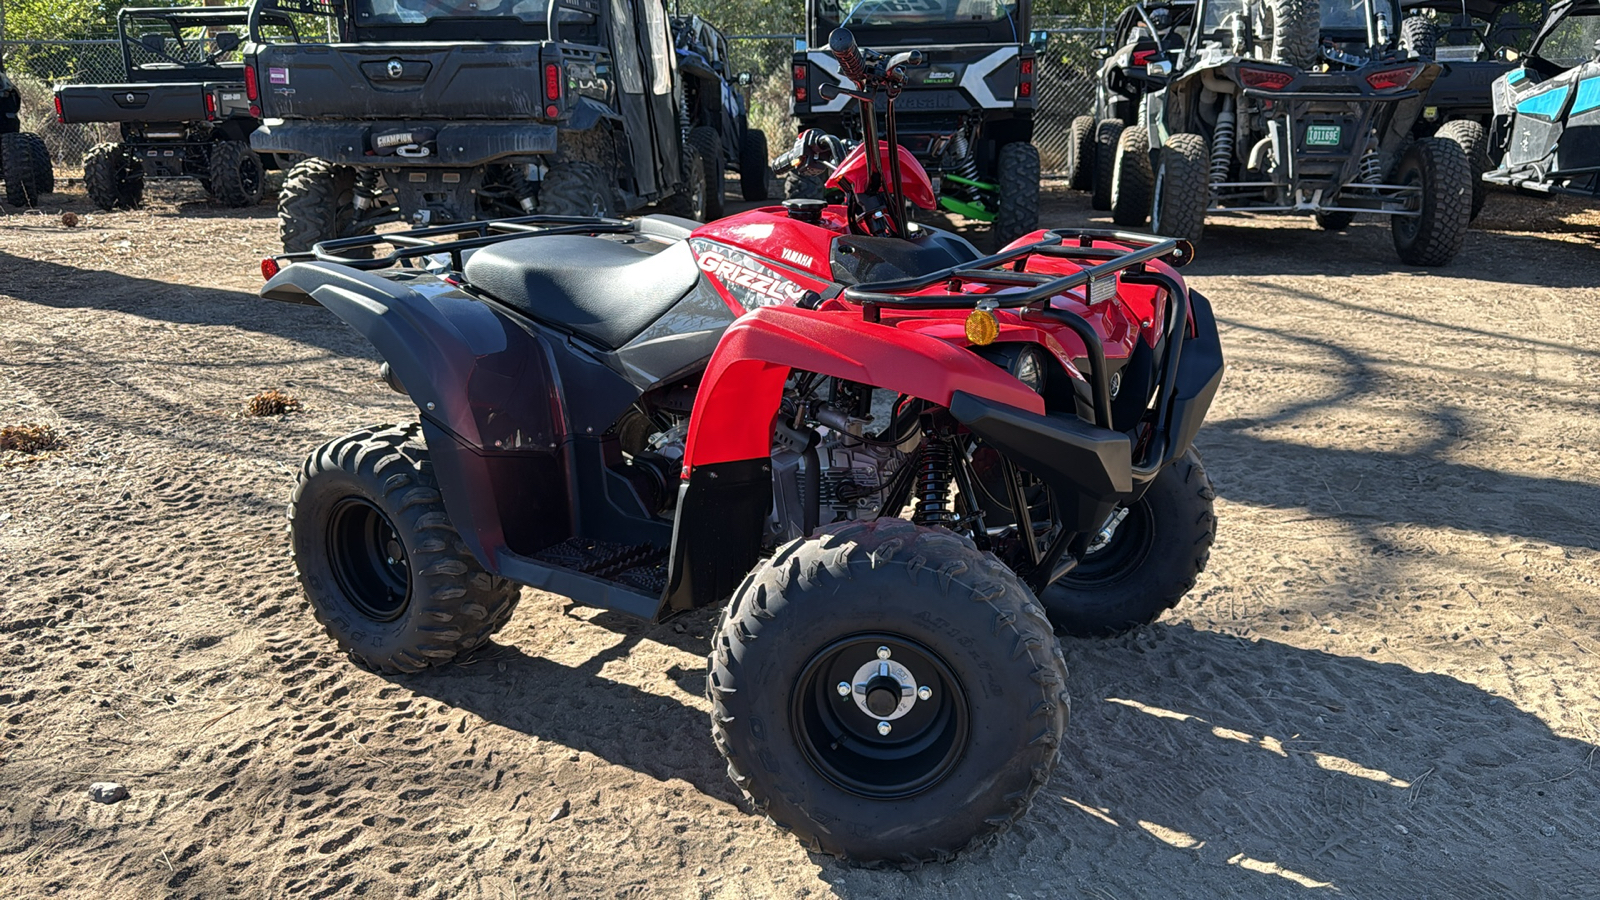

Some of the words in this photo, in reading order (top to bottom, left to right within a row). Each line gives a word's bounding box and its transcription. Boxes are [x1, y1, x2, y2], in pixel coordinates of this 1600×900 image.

[377, 133, 413, 145] CHAMPION
[781, 247, 814, 268] YAMAHA
[697, 250, 808, 302] GRIZZLY
